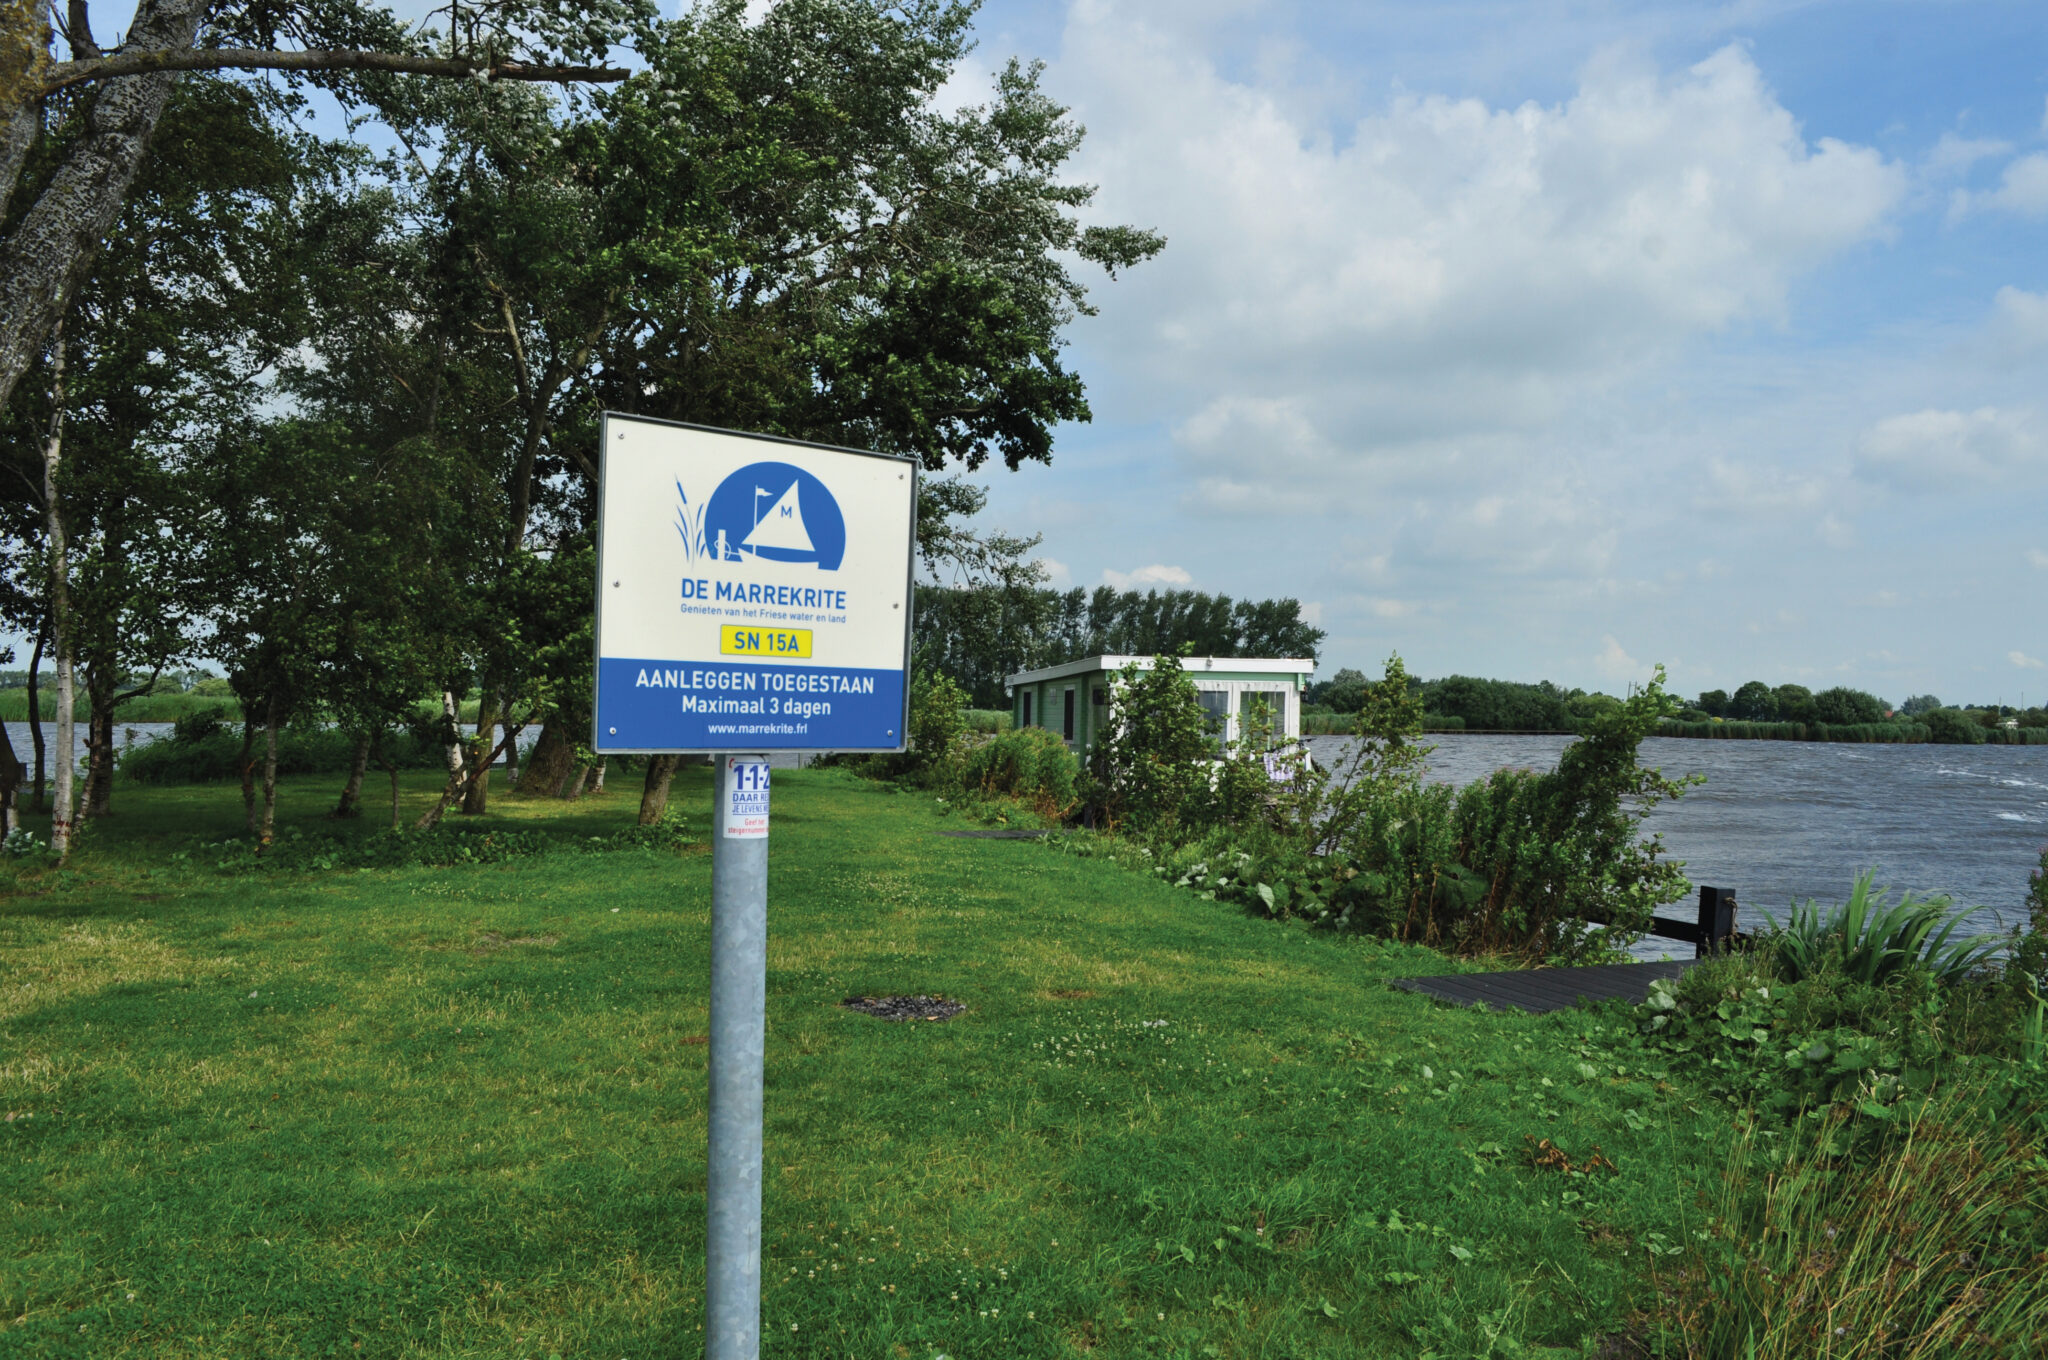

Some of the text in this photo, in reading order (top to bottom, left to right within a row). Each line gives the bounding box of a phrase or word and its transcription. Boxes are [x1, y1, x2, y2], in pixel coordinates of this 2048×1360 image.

[781, 504, 792, 519] M
[681, 578, 846, 609] DE MARREKRITE
[680, 603, 722, 615] Genieten
[724, 607, 740, 617] van
[743, 607, 757, 617] het
[760, 609, 787, 620] Friese
[790, 612, 813, 622] water
[828, 614, 846, 624] land
[734, 631, 799, 652] SN 15A
[635, 668, 874, 694] AANLEGGEN TOEGESTAAN
[682, 695, 831, 719] Maximaal 3 dagen
[708, 723, 808, 734] www.marrekrite.frl
[732, 793, 758, 802] DAAR
